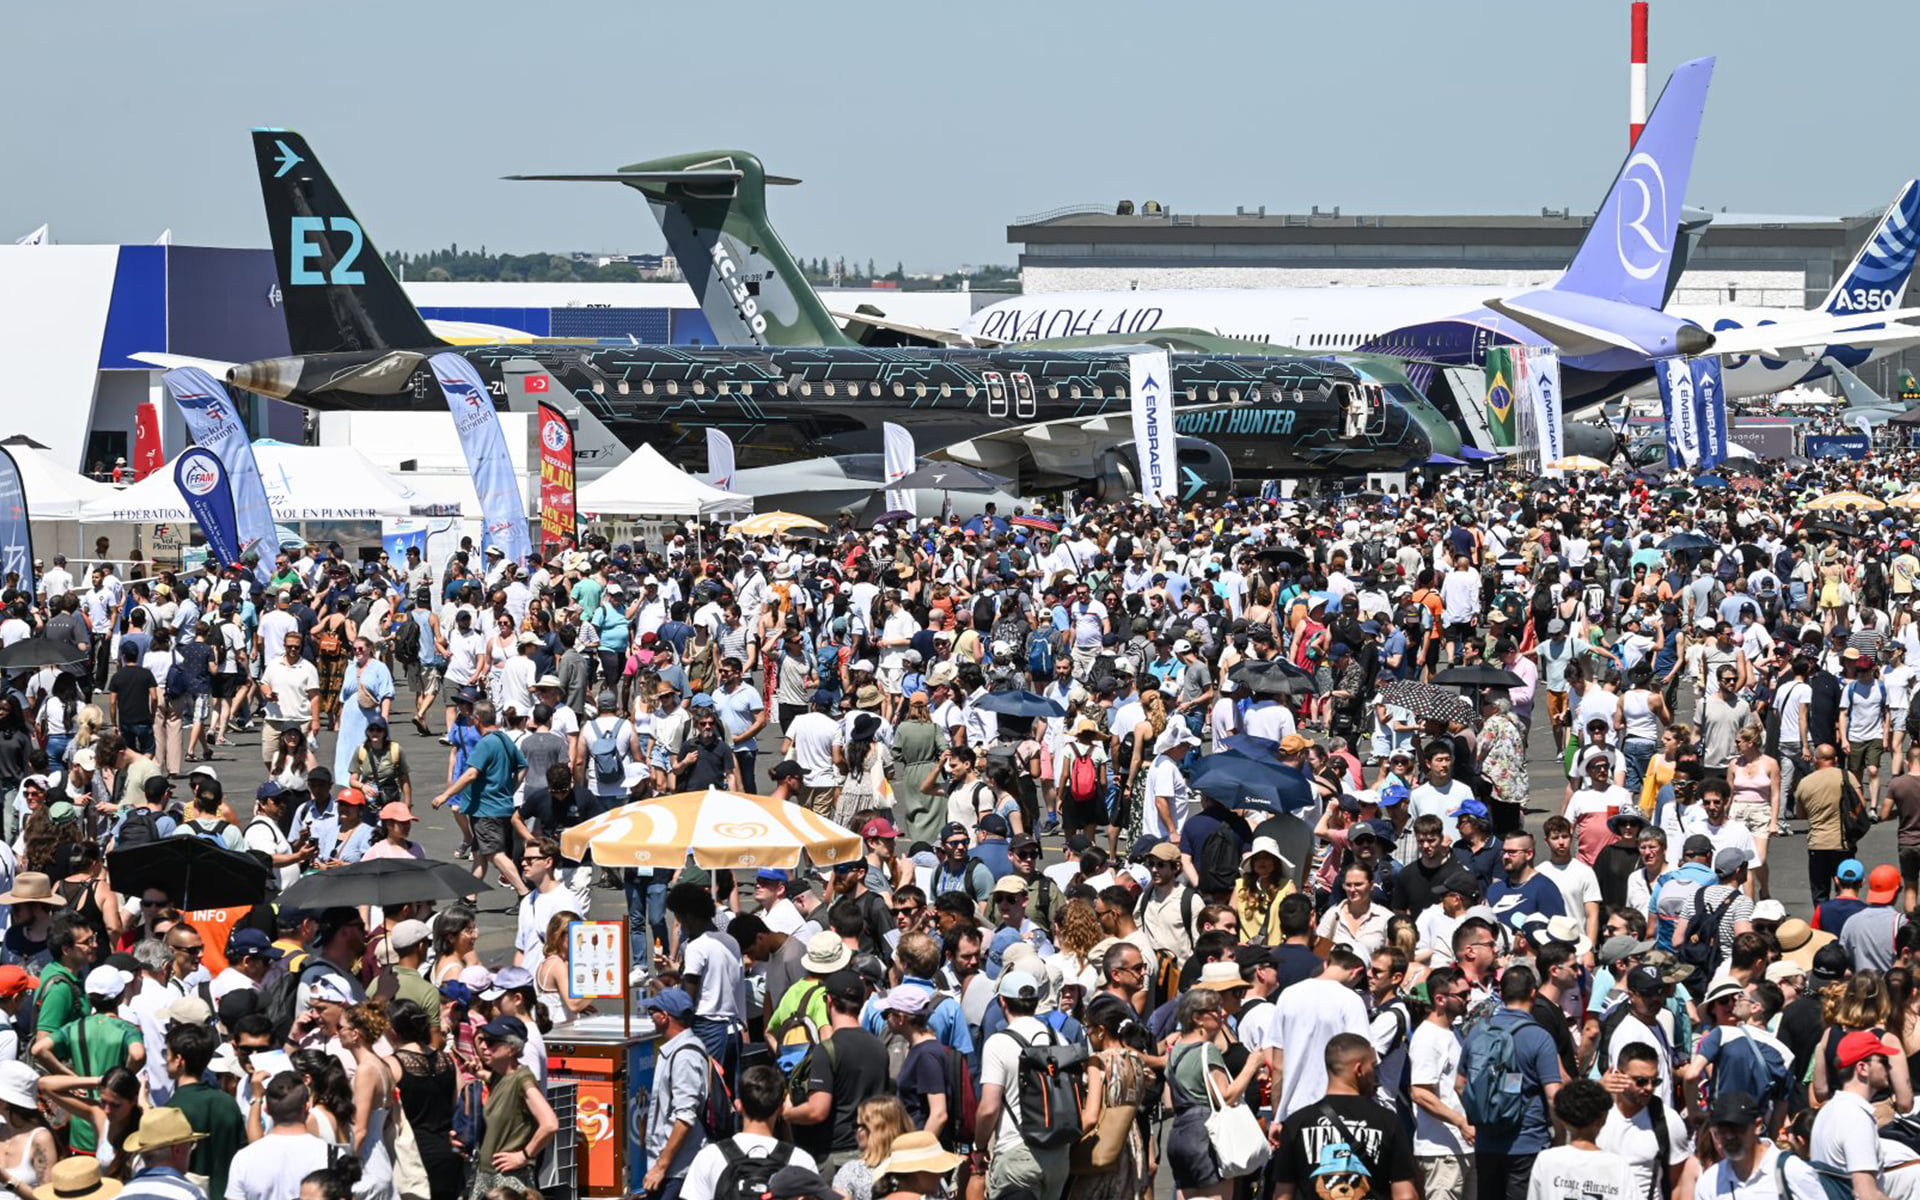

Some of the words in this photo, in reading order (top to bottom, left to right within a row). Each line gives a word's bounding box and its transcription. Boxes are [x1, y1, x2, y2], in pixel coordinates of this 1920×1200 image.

[291, 216, 365, 285] E2
[710, 242, 767, 334] KC-390
[1836, 288, 1895, 310] A350
[980, 309, 1103, 342] RIYADH
[1175, 410, 1229, 433] ROFIT
[1227, 409, 1296, 434] HUNTER
[1681, 389, 1694, 450] EMBRA
[1704, 388, 1718, 456] EMBRAER
[1146, 395, 1162, 488] EMBRAER
[190, 473, 215, 483] FFAM
[276, 509, 296, 518] VOL
[303, 509, 318, 518] EN
[322, 508, 376, 518] PLANEUR
[193, 909, 226, 922] INFO
[1554, 1176, 1579, 1189] Create
[1582, 1180, 1619, 1195] Miracles
